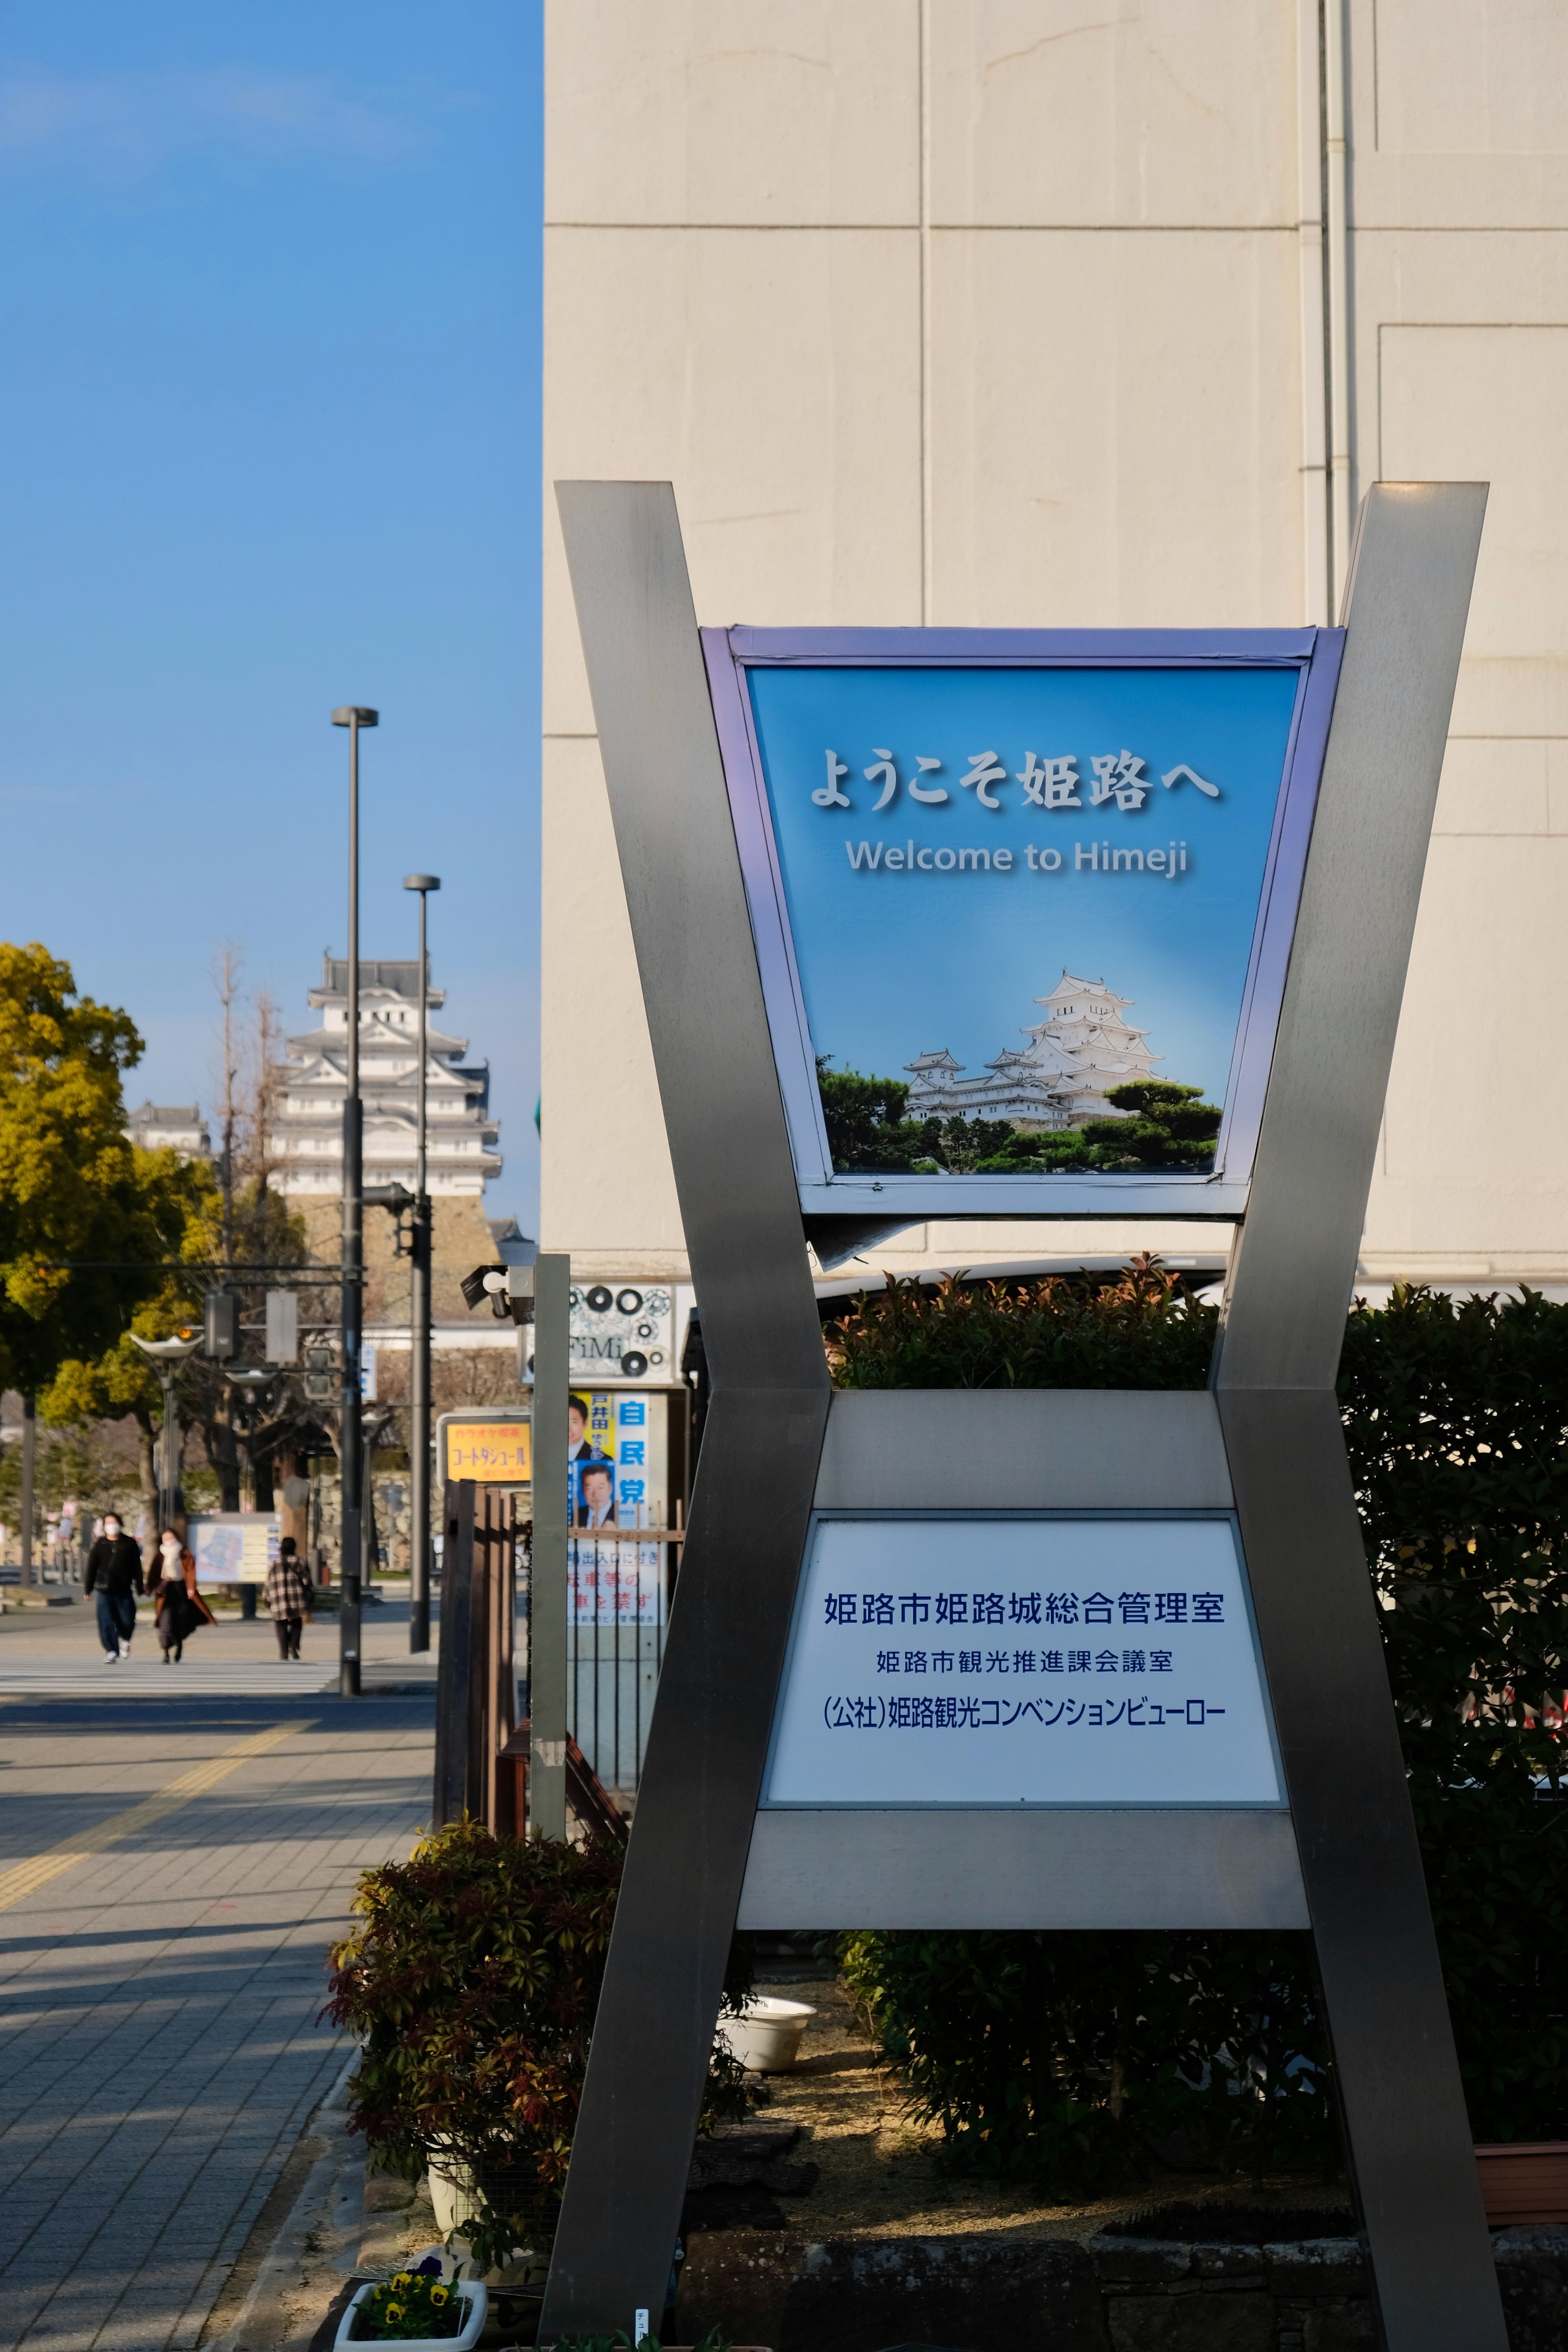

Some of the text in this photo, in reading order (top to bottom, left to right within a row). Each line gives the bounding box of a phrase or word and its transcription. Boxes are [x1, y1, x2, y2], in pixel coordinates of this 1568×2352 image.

[811, 749, 1219, 811] ようこそ姫路へ
[846, 840, 1186, 878] Welcome to Himeji
[452, 1446, 526, 1466] コートダジュール
[620, 1401, 645, 1504] 自民党
[824, 1592, 1225, 1625] 姫路市姫路城総合管理室
[877, 1650, 1173, 1673] 姫路市観光推進課会議室
[824, 1696, 1226, 1729] (公社)姫路観光コンベンションビューロー
